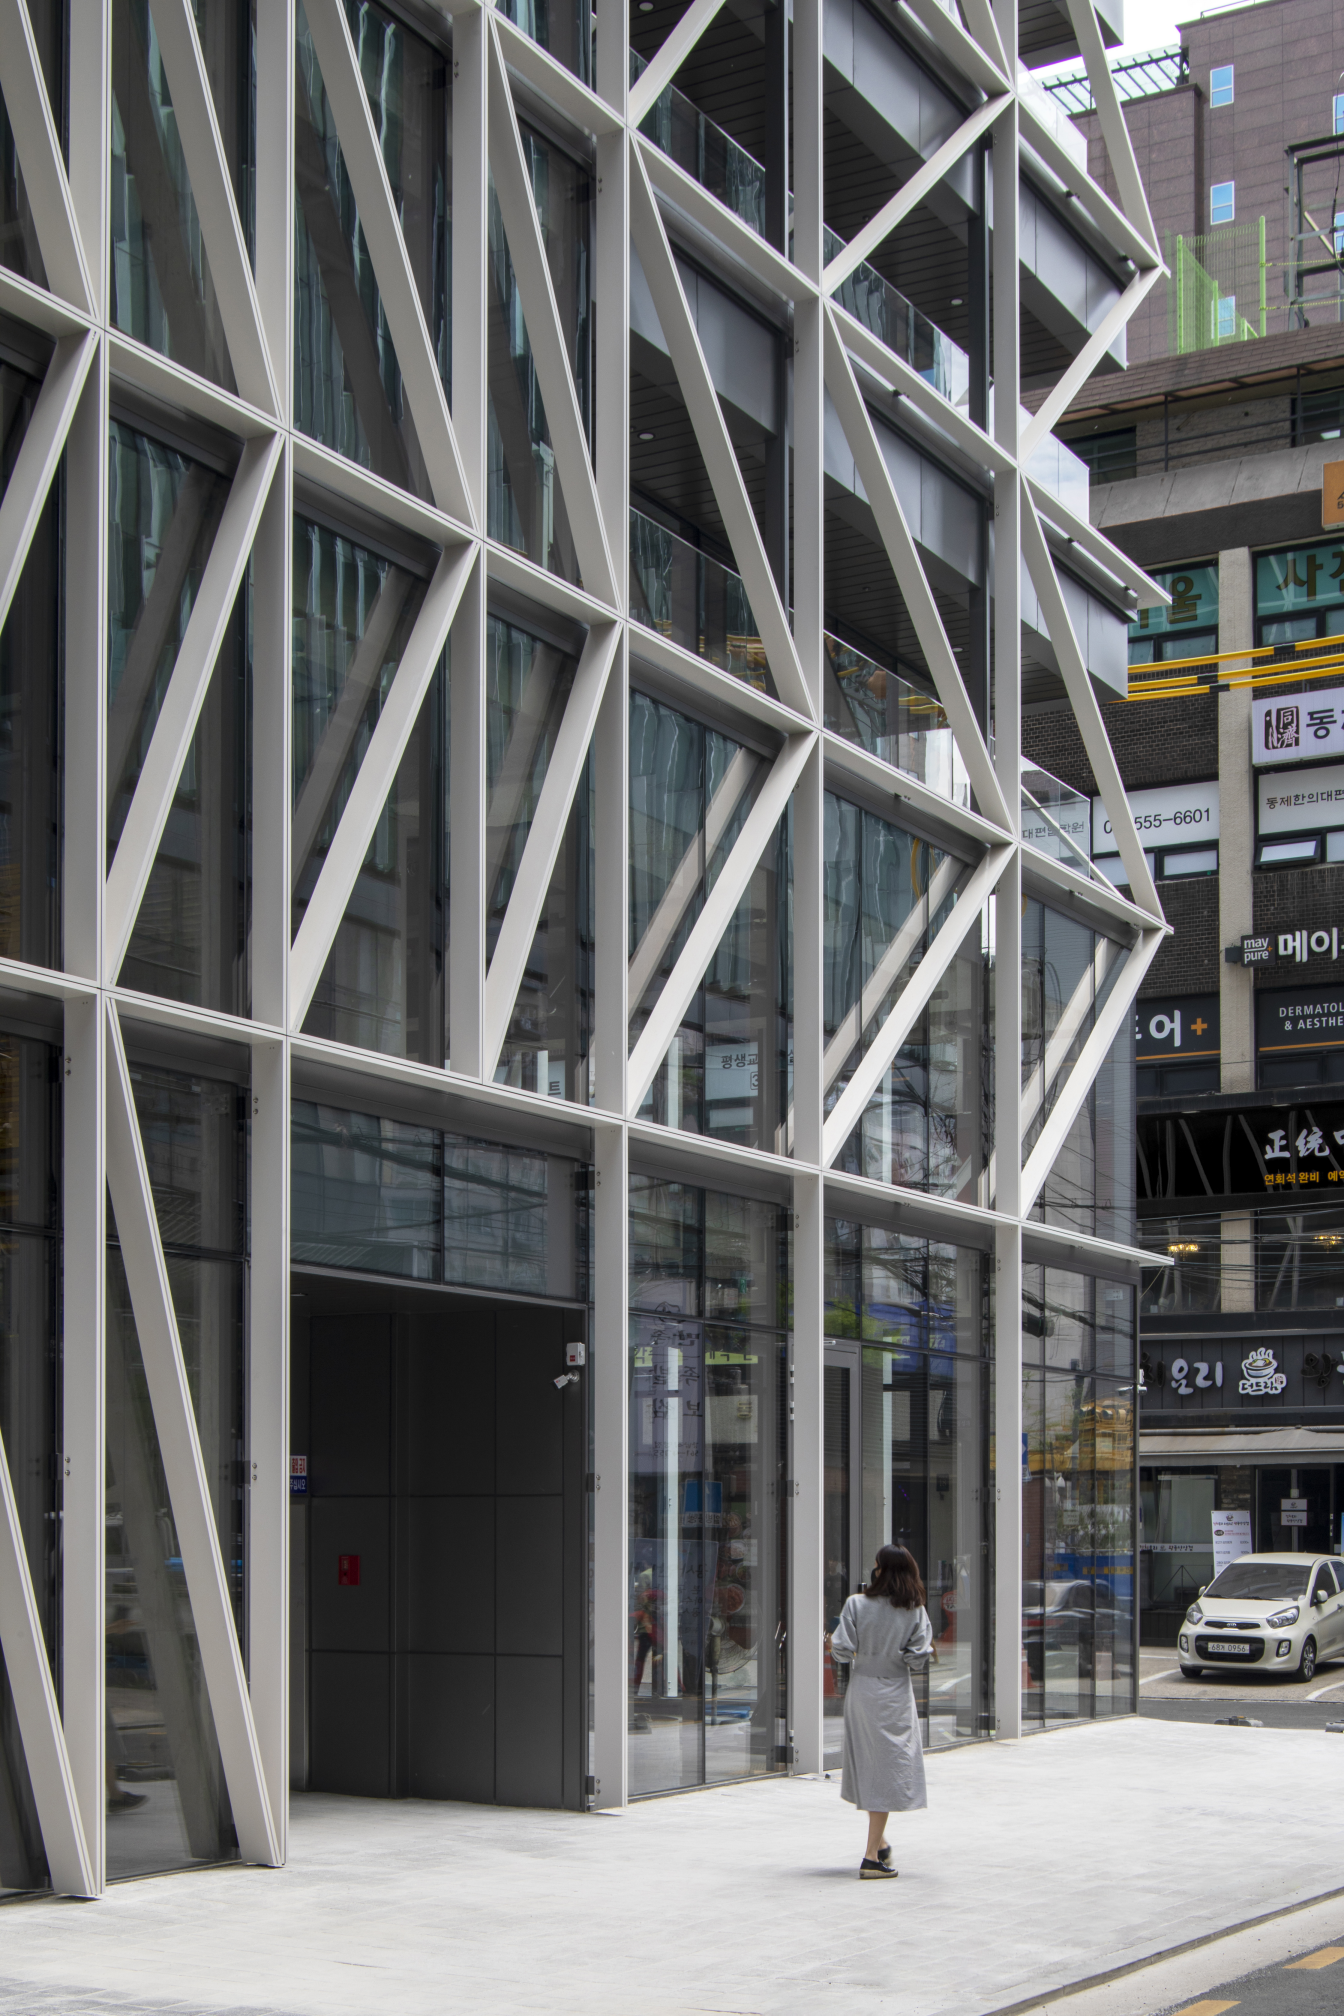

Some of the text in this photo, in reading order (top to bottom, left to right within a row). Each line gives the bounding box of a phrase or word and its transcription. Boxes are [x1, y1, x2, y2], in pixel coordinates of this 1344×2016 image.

[1244, 937, 1269, 950] may
[1278, 927, 1344, 963] 메이
[1244, 950, 1269, 964] pure
[1284, 1016, 1344, 1031] & AESTHE
[1227, 1644, 1246, 1653] 0956
